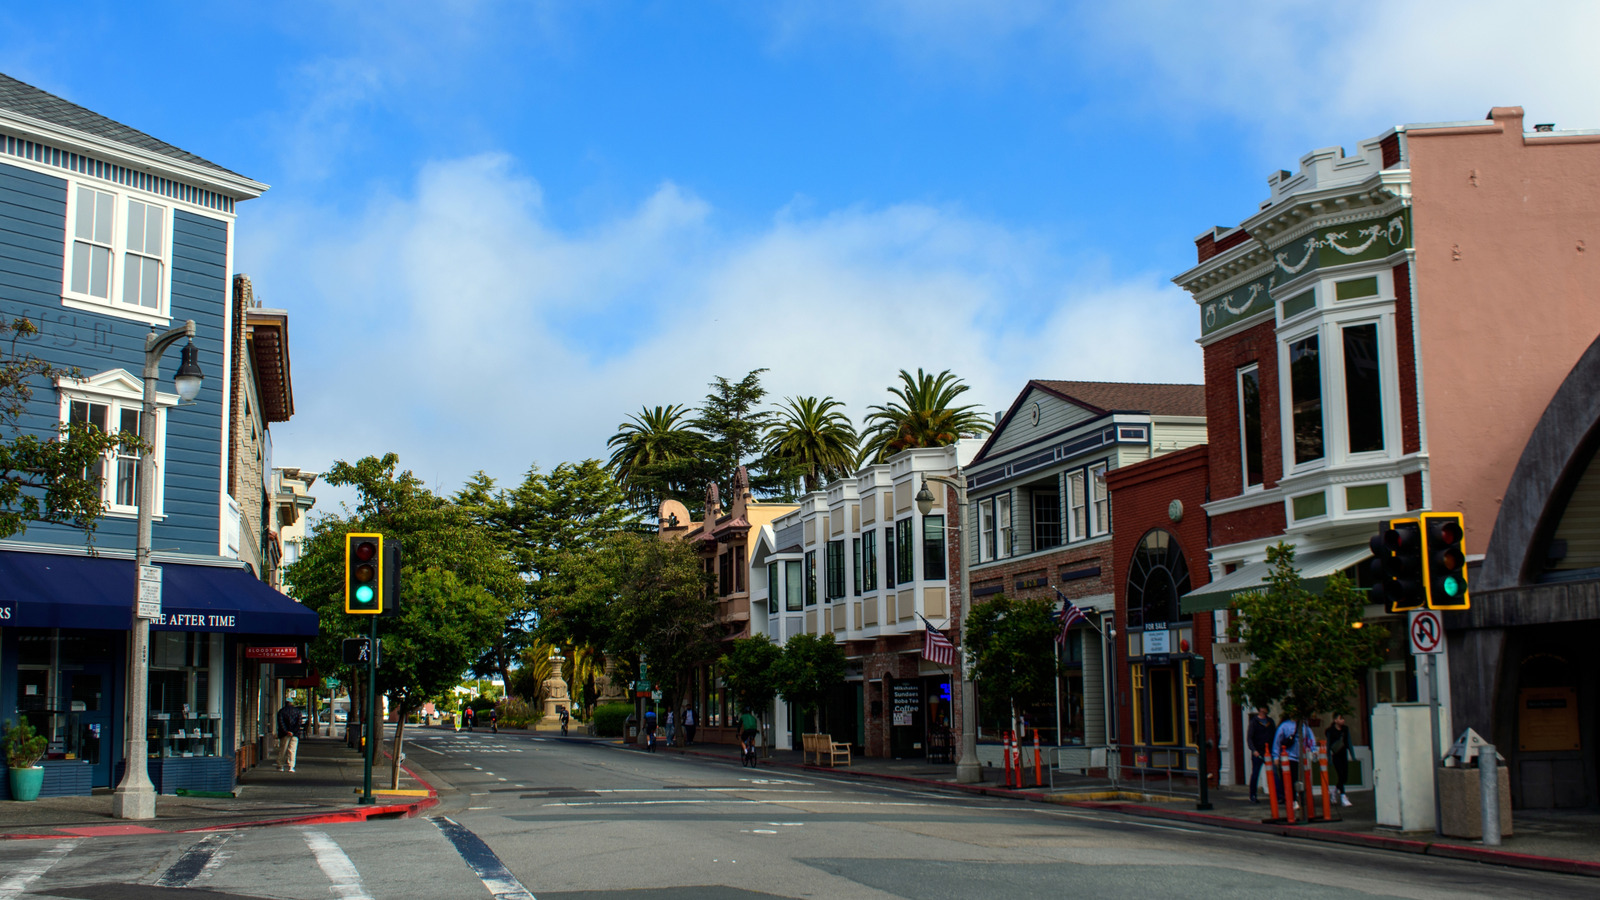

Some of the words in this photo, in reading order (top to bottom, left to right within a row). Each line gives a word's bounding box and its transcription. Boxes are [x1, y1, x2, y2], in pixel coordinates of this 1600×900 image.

[169, 615, 206, 626] AFTER
[209, 615, 236, 627] TIME
[1145, 623, 1155, 631] FOR
[1155, 622, 1167, 630] SALE
